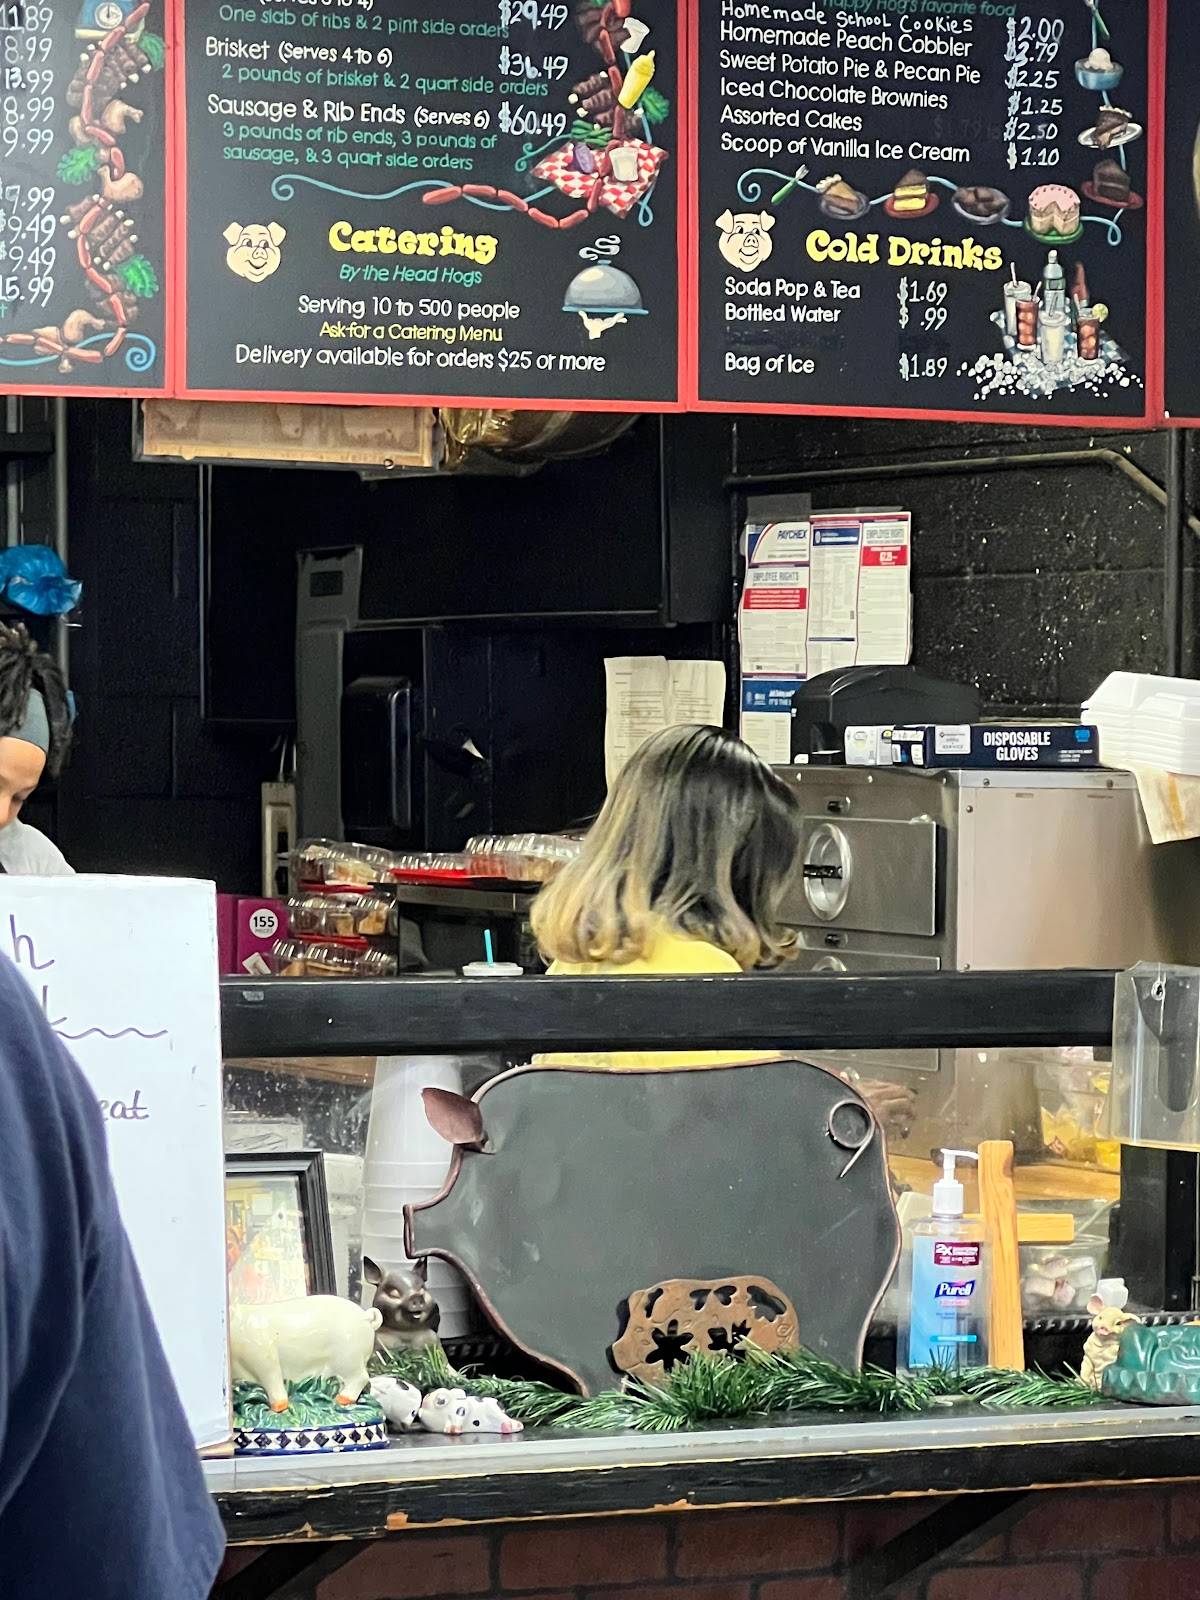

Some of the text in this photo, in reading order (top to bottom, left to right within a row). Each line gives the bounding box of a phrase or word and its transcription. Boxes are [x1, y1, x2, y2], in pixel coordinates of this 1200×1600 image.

[220, 0, 568, 38] One slab of ribs & 2 pint side orders $29.49
[721, 0, 827, 25] Homemade
[1006, 16, 1065, 43] $2.00
[920, 0, 977, 15] favorite
[980, 3, 1017, 17] food
[720, 20, 831, 47] Homemade
[837, 29, 892, 51] Peach
[898, 34, 973, 57] Cobbler
[206, 36, 270, 60] Brisket
[278, 40, 338, 64] (Serves
[342, 46, 354, 63] 4
[376, 47, 393, 68] 6)
[498, 46, 568, 80] $36.49
[719, 49, 777, 72] Sweet
[781, 54, 839, 75] Potato
[843, 57, 870, 78] Pie
[874, 60, 888, 79] &
[894, 61, 950, 82] Pecan
[955, 64, 981, 84] Pie
[221, 64, 548, 96] 2 pounds of brisket & 2 quart side orders
[4, 96, 55, 125] 8.99
[720, 77, 1063, 117] Iced Chocolate Brownies $1.25
[207, 94, 567, 136] Sausage & Rib Ends (Serves 6) $60.49
[720, 104, 800, 127] Assorted
[805, 109, 862, 131] Cakes
[1004, 116, 1058, 141] $2.50
[3, 126, 54, 157] 9.99
[222, 121, 498, 149] 3 pounds of rib ends, 3 pounds of
[223, 147, 473, 170] sausage, & 3 quart side orders
[721, 132, 1060, 170] Scoop of Vanilla Ice Cream $1.10
[329, 221, 499, 265] Catering
[805, 229, 1003, 271] Cold Drinks
[339, 264, 482, 287] By the Head Hogs
[725, 276, 948, 305] Soda Pop & Tea $1.69
[298, 295, 520, 321] Serving 10 to 500 people
[725, 302, 785, 322] Bottled
[790, 305, 841, 323] Water
[319, 321, 503, 344] Ask for a Catering Menu
[236, 344, 606, 372] Delivery available for orders $25 or more
[725, 352, 948, 381] Bag of Ice $1.89
[983, 731, 1051, 746] DISPOSABLE
[996, 746, 1039, 761] GLOVES
[253, 916, 275, 927] 155
[939, 1282, 973, 1296] Purell
